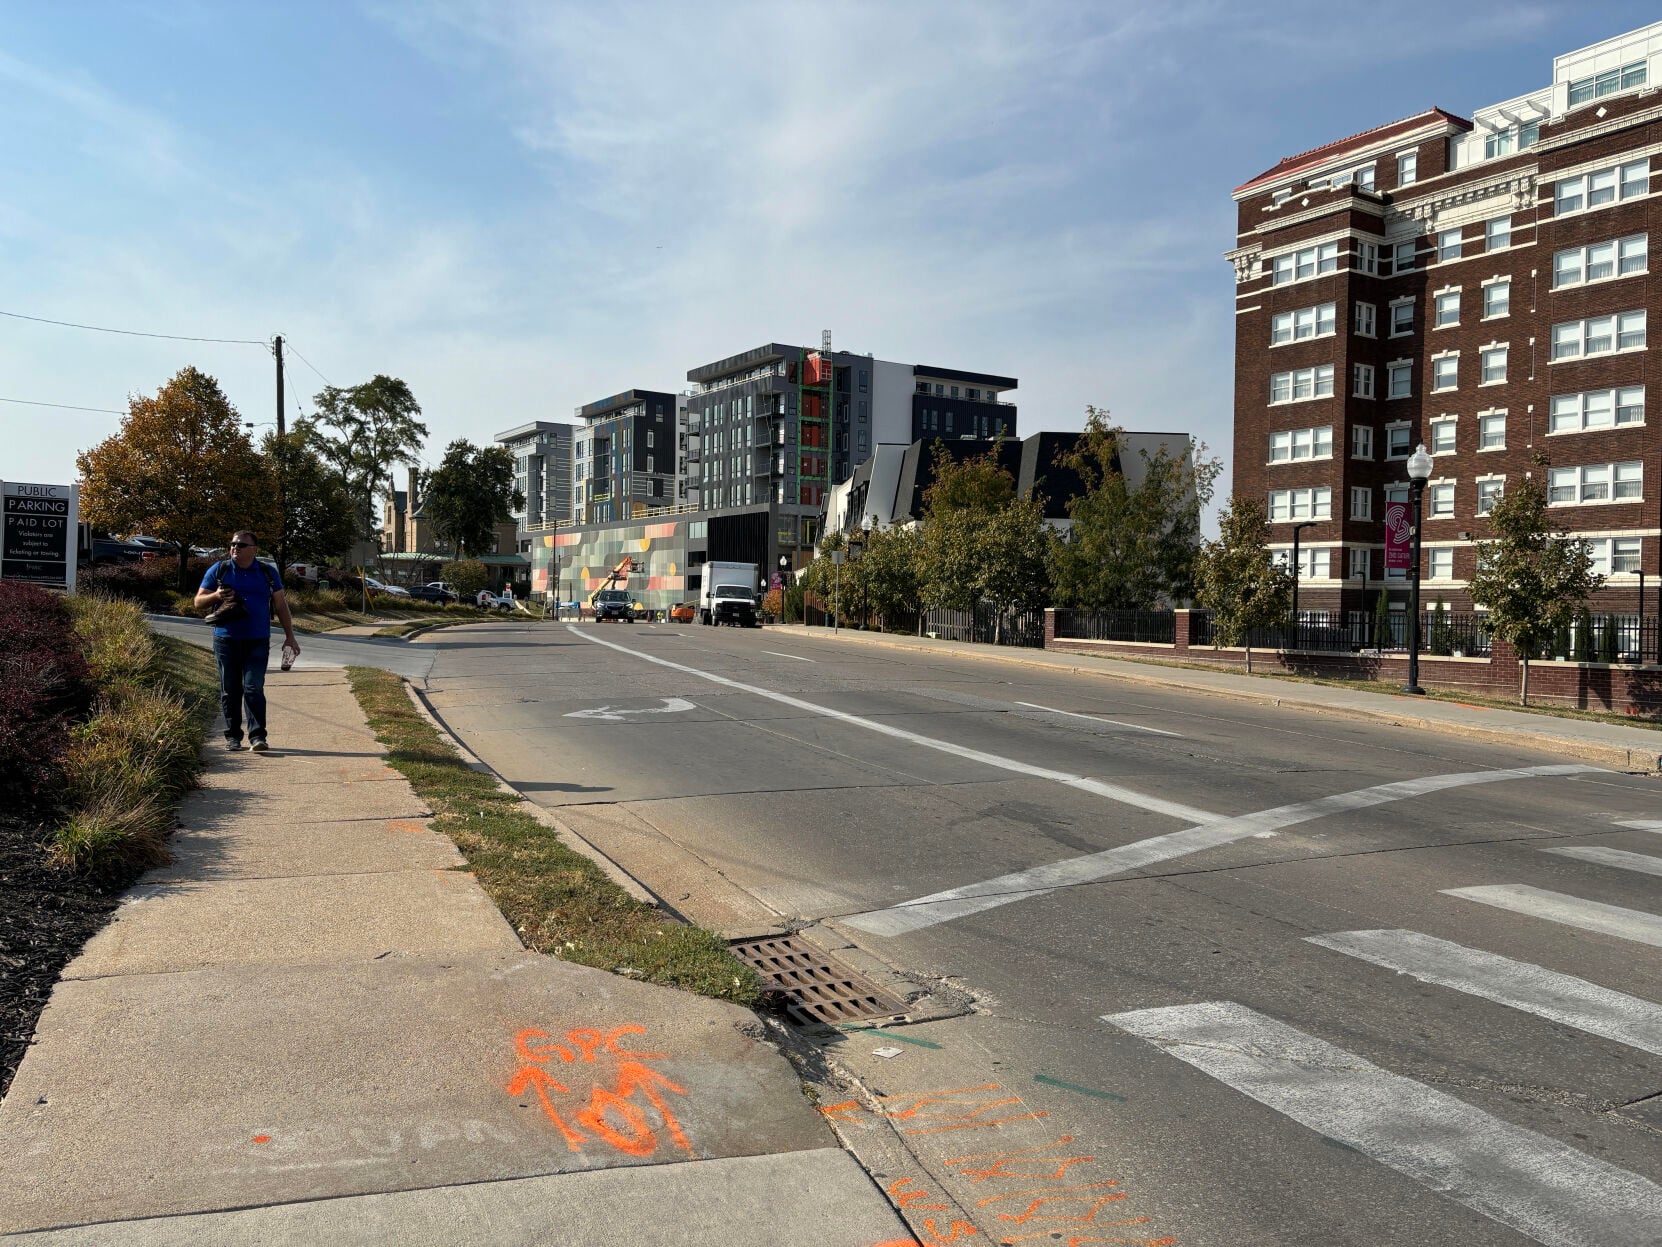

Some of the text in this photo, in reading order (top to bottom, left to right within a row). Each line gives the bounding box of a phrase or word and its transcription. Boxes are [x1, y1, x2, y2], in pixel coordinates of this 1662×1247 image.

[17, 485, 57, 497] PUBLIC
[9, 499, 65, 512] PARKING
[8, 517, 63, 528] PAID LOT
